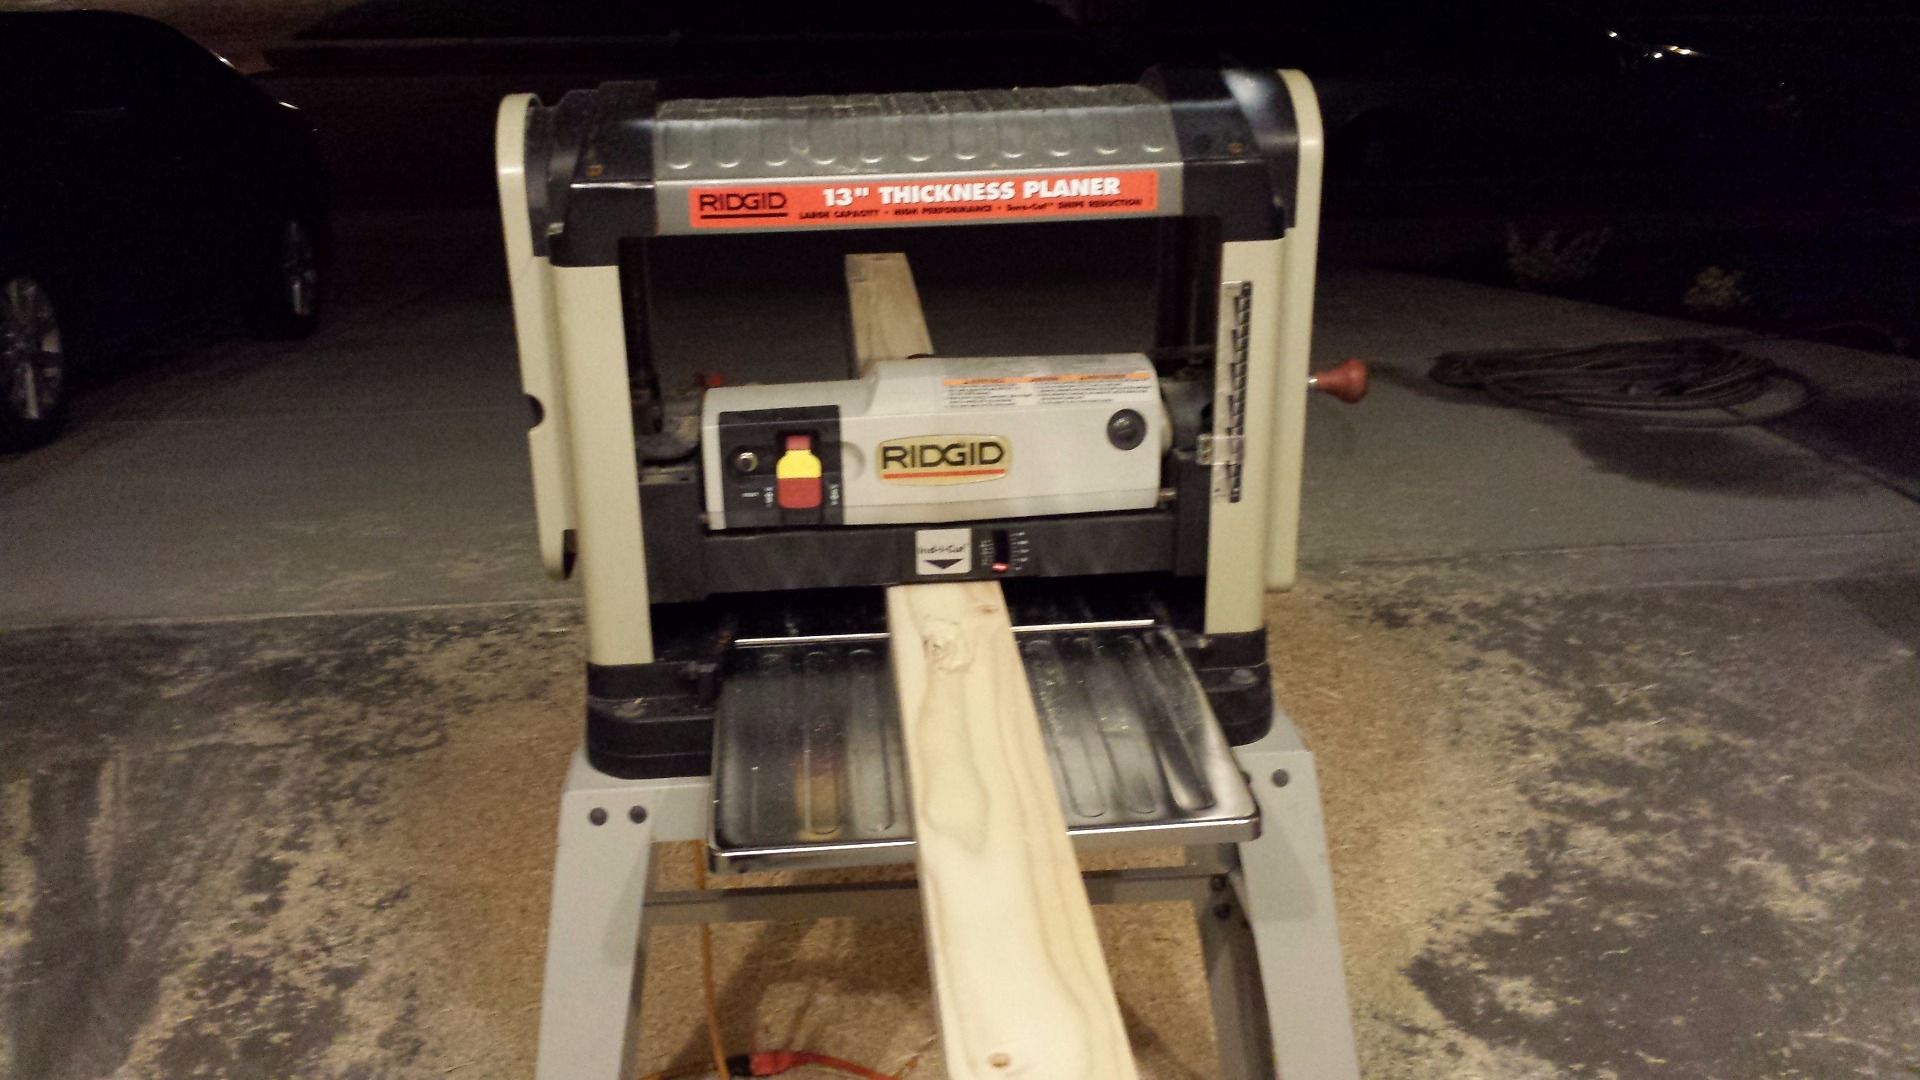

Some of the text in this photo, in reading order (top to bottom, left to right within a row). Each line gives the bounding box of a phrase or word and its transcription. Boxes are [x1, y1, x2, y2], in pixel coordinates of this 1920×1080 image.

[699, 192, 787, 211] RIDGID
[822, 177, 1120, 208] 13" THICKNESS PLANER
[834, 209, 879, 218] CAPACITY
[882, 442, 1004, 469] RIDGID
